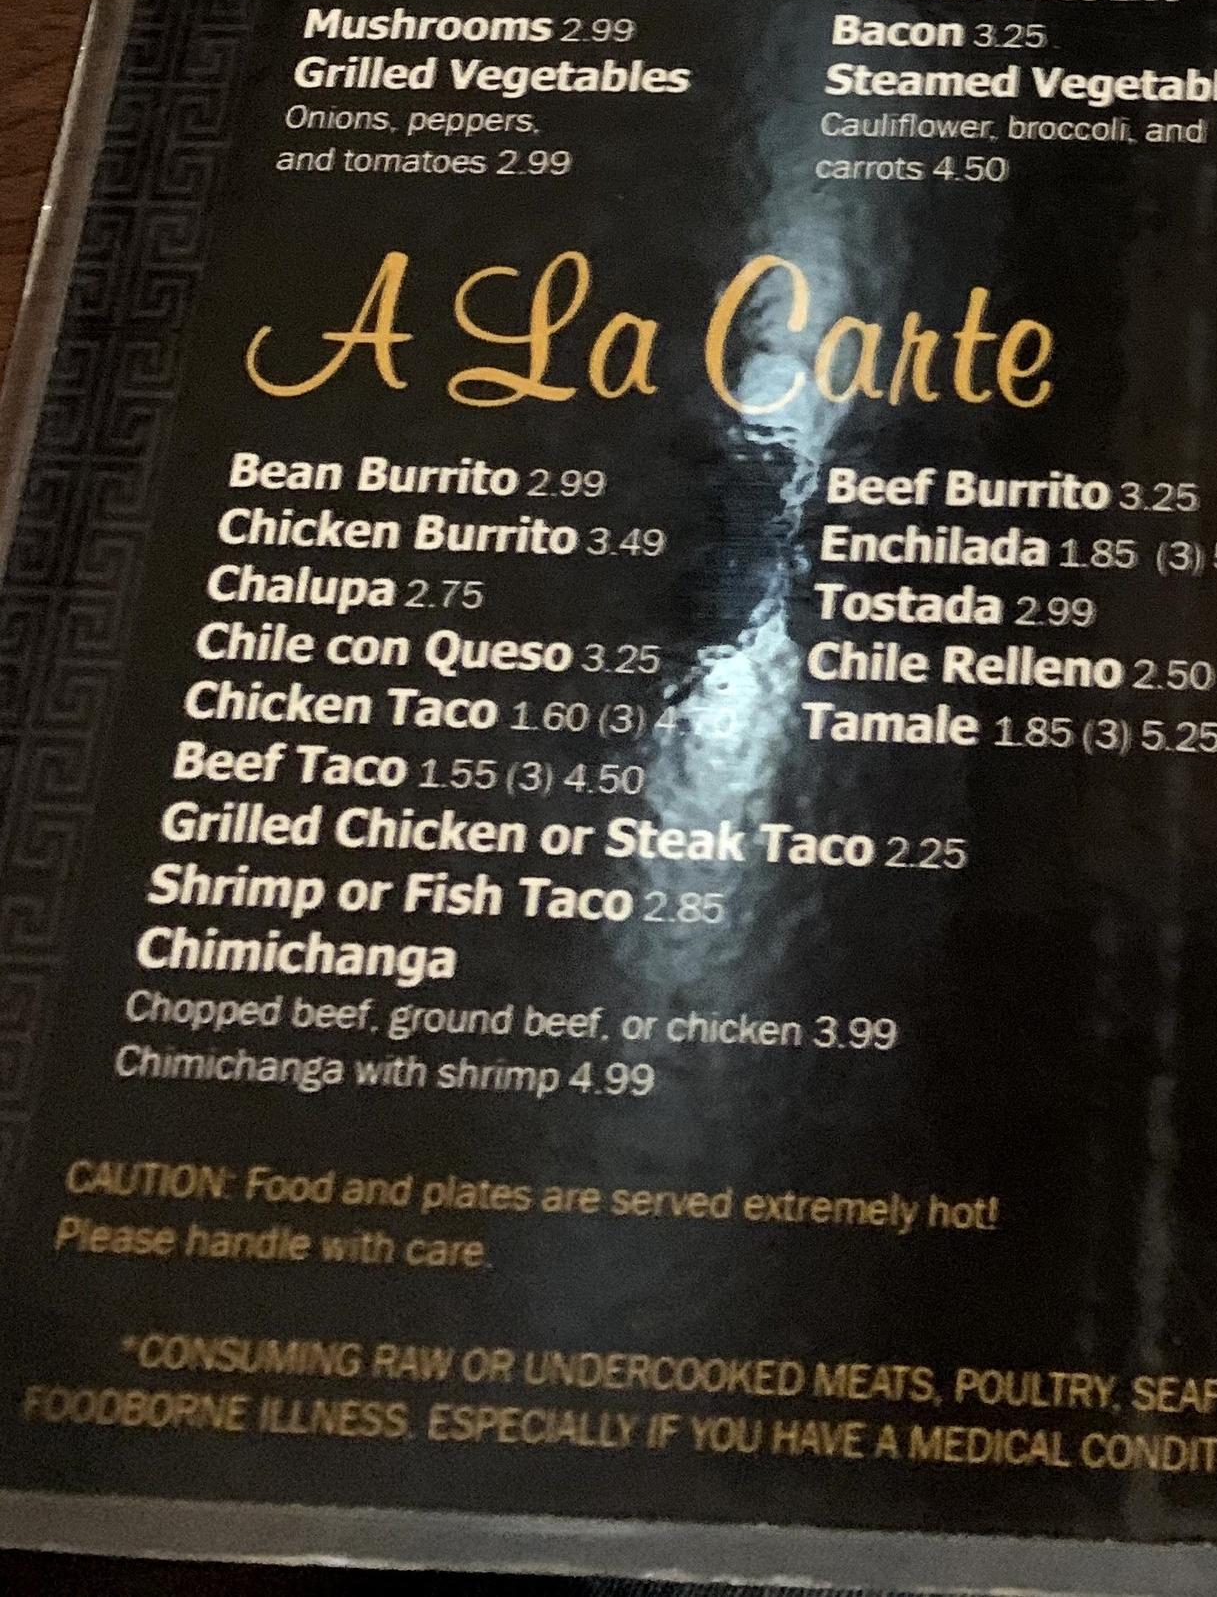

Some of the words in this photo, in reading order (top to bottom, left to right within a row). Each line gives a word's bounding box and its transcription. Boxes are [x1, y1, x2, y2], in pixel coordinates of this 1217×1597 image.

[294, 56, 437, 89] Grilled
[451, 60, 691, 98] Vegetables
[825, 64, 1020, 98] Steamed
[276, 148, 335, 171] and
[344, 150, 486, 173] tomatoes
[496, 150, 572, 174] 2.99
[816, 158, 924, 180] carrots
[933, 156, 1009, 181] 4.50
[246, 252, 413, 396] A
[448, 251, 658, 407] La
[704, 255, 1053, 413] Carte
[230, 452, 342, 490] Bean
[358, 456, 519, 495] Burrito
[527, 469, 604, 497] 2.99
[821, 525, 1049, 567] Enchilada
[1060, 539, 1135, 568] 1.85
[1157, 542, 1200, 571] (3)
[196, 621, 314, 663] Chile
[327, 635, 409, 665] con
[425, 629, 573, 677] Queso
[582, 644, 659, 673] 3.25
[161, 801, 322, 845] Grilled
[335, 807, 526, 853] Chicken
[541, 824, 595, 855] or
[605, 819, 744, 861] Steak
[760, 823, 875, 867] Taco
[885, 837, 966, 869] 2.25
[137, 926, 456, 988] Chimichanga
[115, 1044, 344, 1092] Chimichanga
[356, 1055, 427, 1087] with
[437, 1058, 559, 1099] shrimp
[569, 1061, 655, 1096] 4.99
[246, 1166, 335, 1203] Food
[341, 1175, 413, 1207] and
[421, 1175, 532, 1213] plates
[541, 1186, 601, 1213] are
[611, 1187, 733, 1219] served
[744, 1191, 919, 1233] extremely
[929, 1194, 999, 1230] hot!
[55, 1215, 177, 1255] Please
[185, 1224, 311, 1260] handle
[322, 1231, 395, 1264] with
